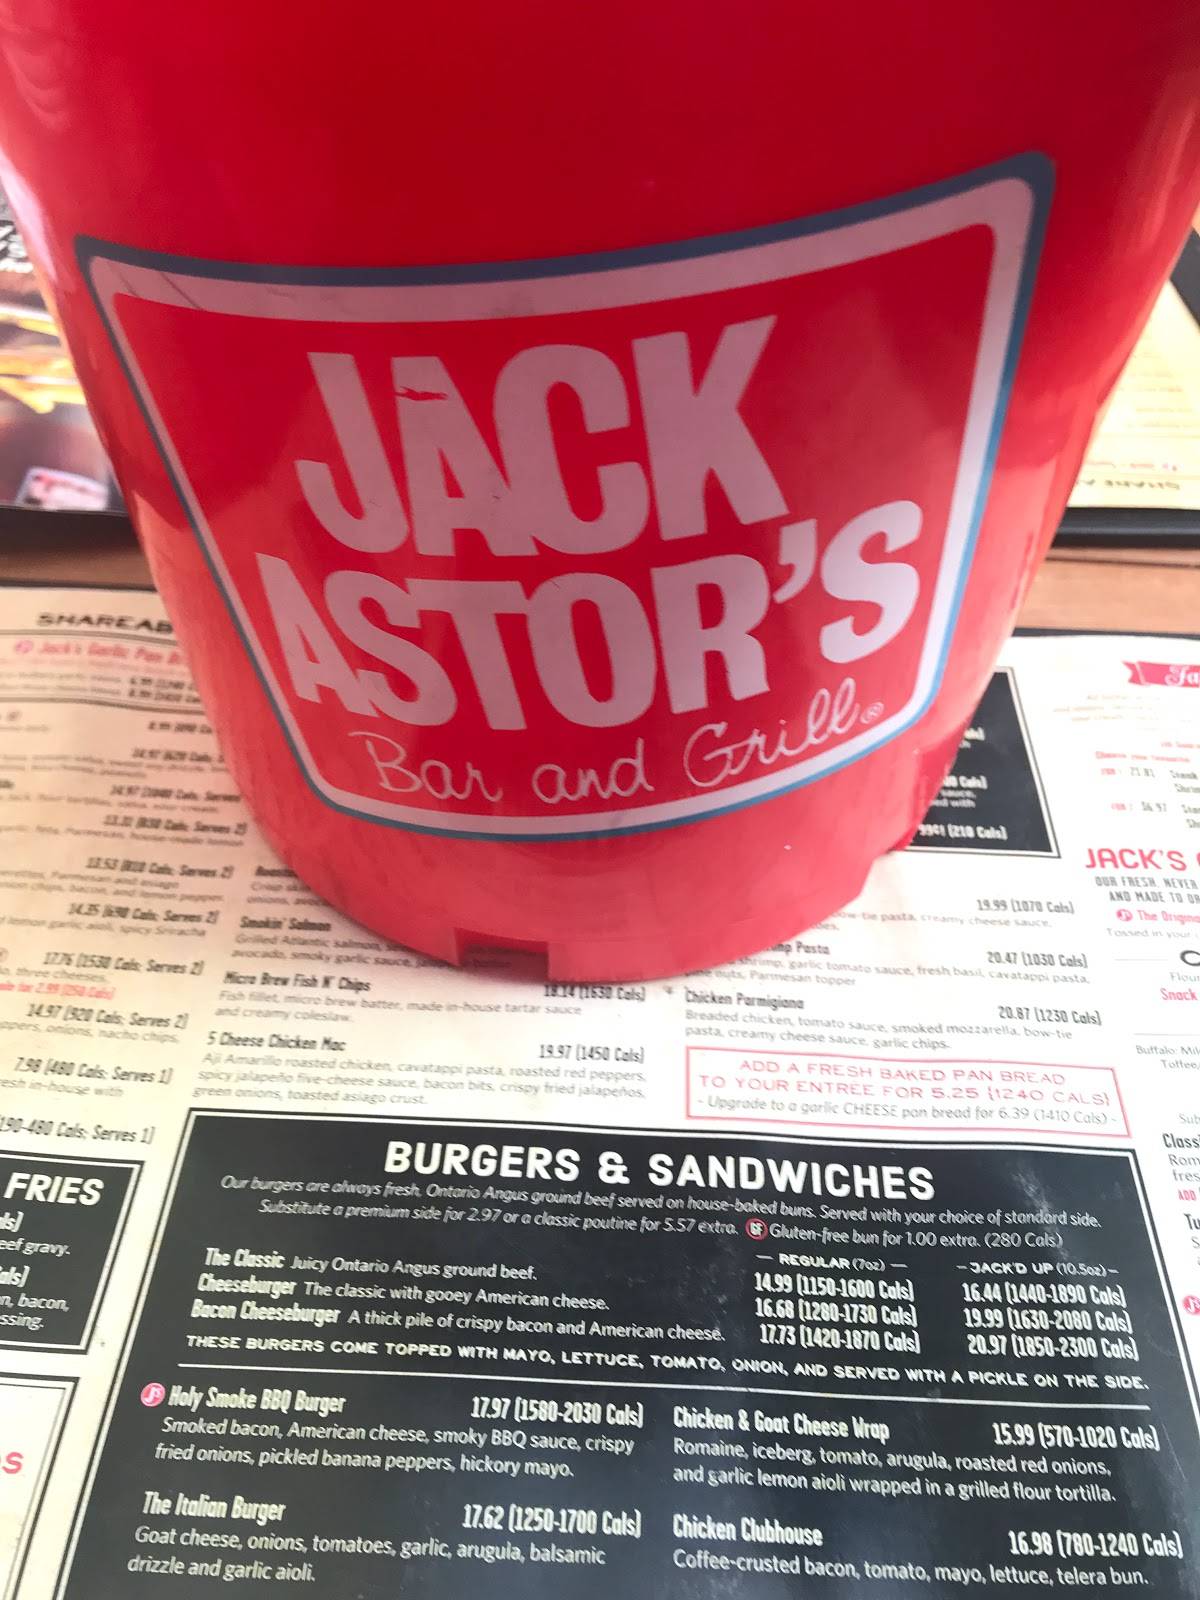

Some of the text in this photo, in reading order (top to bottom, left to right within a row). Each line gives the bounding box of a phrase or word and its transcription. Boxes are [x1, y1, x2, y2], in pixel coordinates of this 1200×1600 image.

[295, 314, 789, 556] JACK
[256, 500, 923, 730] ASTOR'S
[347, 730, 503, 802] Bar
[532, 739, 653, 802] and
[1086, 848, 1187, 871] JACK'S
[684, 988, 733, 1005] Chicken
[736, 993, 804, 1010] Parmigiana
[998, 1006, 1030, 1020] 20.87
[207, 1031, 217, 1046] 5
[219, 1032, 264, 1048] Cheese
[268, 1034, 317, 1050] Chicken
[321, 1037, 347, 1051] Mac
[540, 1044, 572, 1059] 19.97
[700, 1075, 726, 1088] TO
[736, 1077, 789, 1091] YOUR
[797, 1081, 875, 1096] ENTREE
[882, 1086, 924, 1099] FOR
[931, 1088, 979, 1099] 5.25
[740, 1059, 1065, 1085] ADD A FRESH BAKED PAN BREAD
[384, 1140, 935, 1201] BURGERS & SANDWICHES
[3, 1172, 105, 1206] FRIES
[205, 1248, 537, 1281] The Classic Juicy Ontario Angus ground beef.
[778, 1253, 850, 1269] REGULAR
[970, 1262, 1027, 1274] JACK'D
[1032, 1263, 1053, 1274] UP
[197, 1272, 297, 1299] Cheeseburger
[304, 1281, 333, 1297] The
[335, 1281, 386, 1299] classic
[389, 1285, 423, 1301] with
[425, 1288, 472, 1305] gooey
[475, 1288, 549, 1307] American
[754, 1272, 793, 1293] 14.99
[962, 1282, 1002, 1303] 16.44
[191, 1298, 725, 1341] Bacon Cheeseburger A thick pile of crispy bacon and American cheese.
[754, 1297, 794, 1319] 16.68
[963, 1308, 1004, 1328] 19.99
[759, 1323, 796, 1345] 17.73
[967, 1334, 1007, 1356] 20.97
[187, 1335, 1150, 1390] THESE BURGERS COME TOPPED WITH MAYO, LETTUCE, TOMATO, ONION, AND SERVED WITH A PICKLE ON THE SIDE.
[167, 1384, 204, 1412] Holy
[205, 1386, 257, 1410] Smoke
[260, 1388, 292, 1414] BBQ
[294, 1390, 347, 1417] Burger
[471, 1396, 511, 1419] 17.97
[673, 1405, 734, 1430] Chicken
[738, 1408, 750, 1433] &
[754, 1410, 790, 1434] Goat
[793, 1412, 849, 1438] Cheese
[851, 1416, 890, 1446] Wrap
[992, 1422, 1035, 1446] 15.99
[674, 1437, 1112, 1477] Romaine, iceberg, tomato, arugula, roasted red onions,
[142, 1490, 171, 1515] The
[175, 1492, 228, 1518] Italian
[231, 1495, 286, 1526] Burger
[462, 1503, 504, 1530] 17.62
[673, 1513, 736, 1540] Chicken
[740, 1517, 823, 1546] Clubhouse
[1008, 1530, 1053, 1556] 16.98
